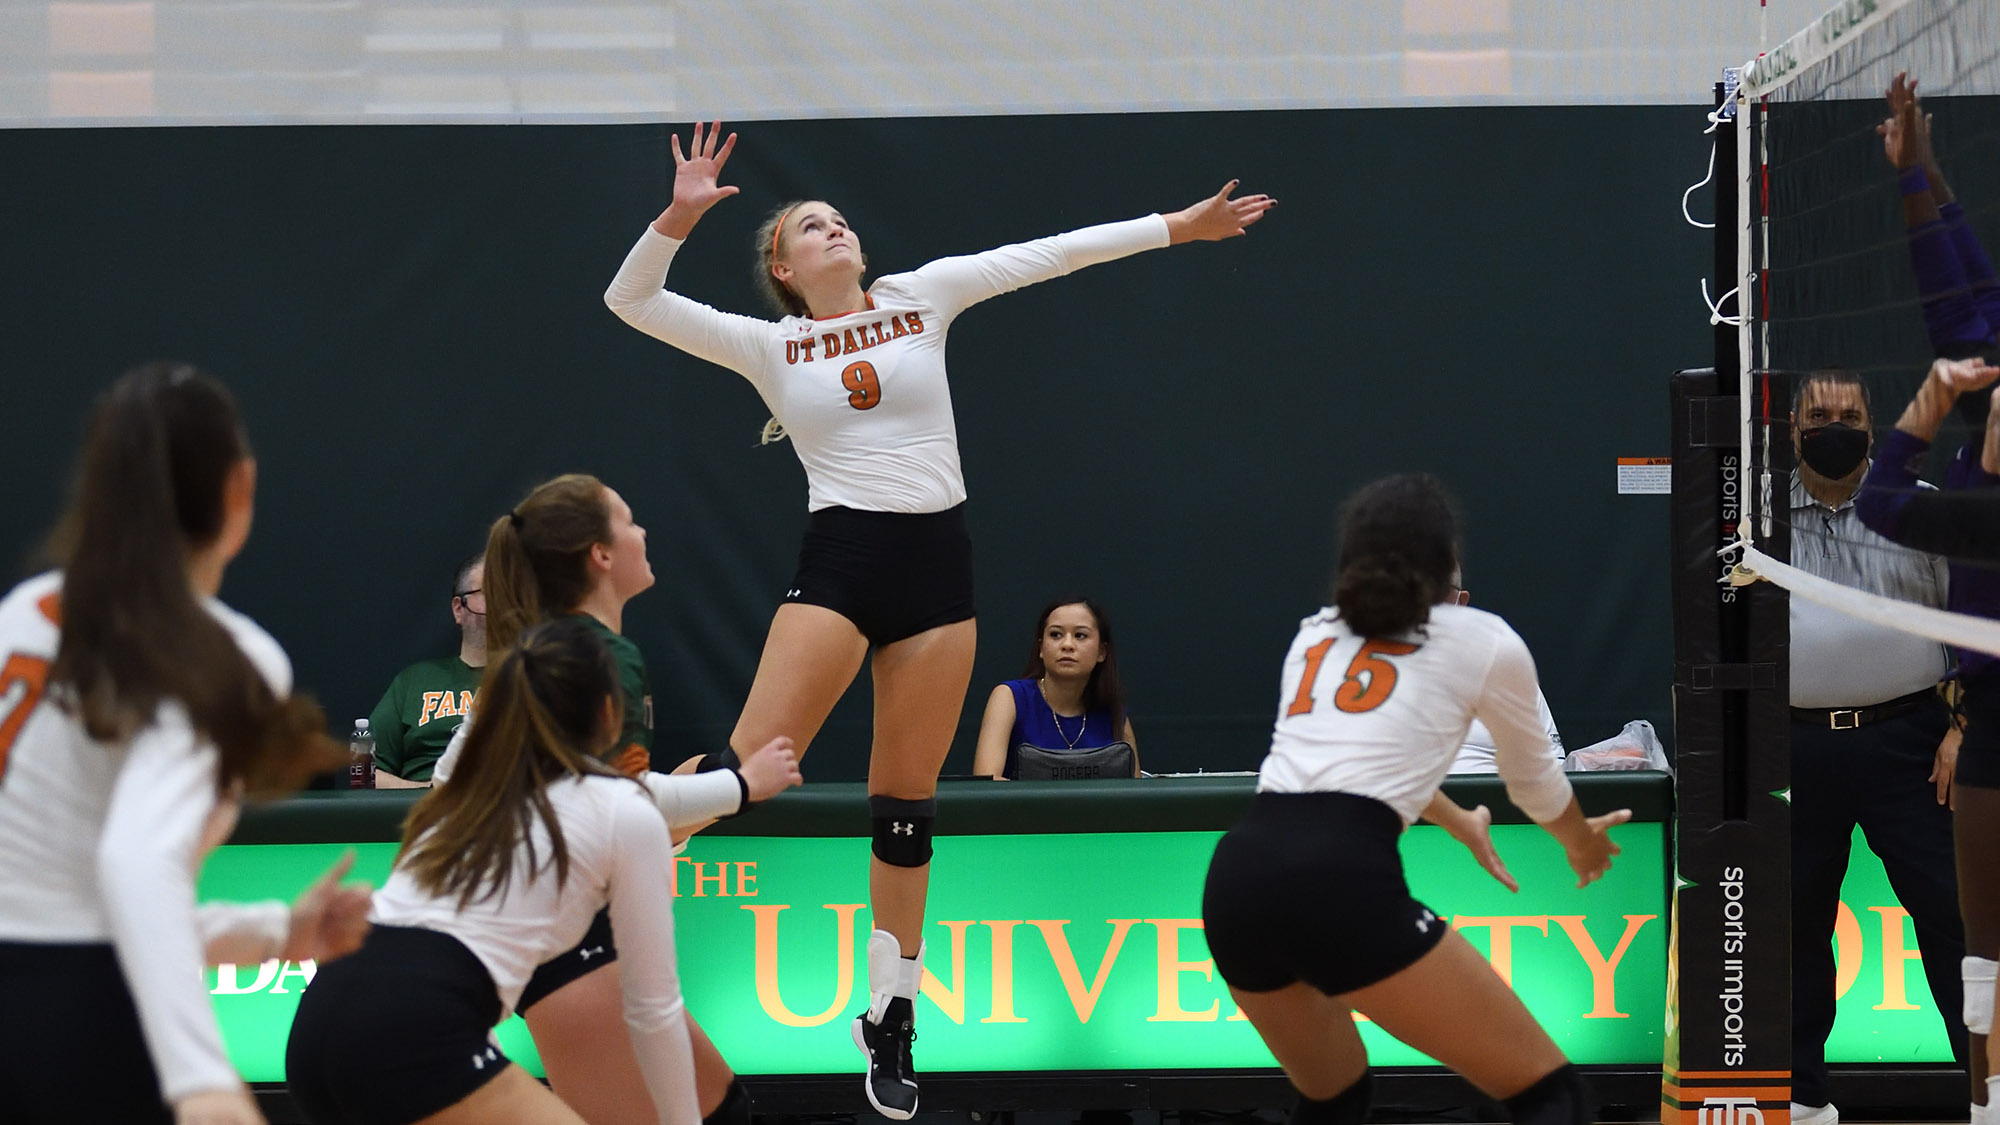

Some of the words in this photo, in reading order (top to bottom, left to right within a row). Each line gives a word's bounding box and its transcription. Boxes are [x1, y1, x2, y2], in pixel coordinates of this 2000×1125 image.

[786, 337, 815, 364] UT
[822, 312, 924, 359] DALLAS
[841, 360, 881, 410] 9
[1720, 456, 1739, 520] sports
[1287, 636, 1423, 718] 15
[671, 857, 759, 898] THE
[1719, 866, 1747, 954] sports
[1719, 959, 1747, 1067] imports
